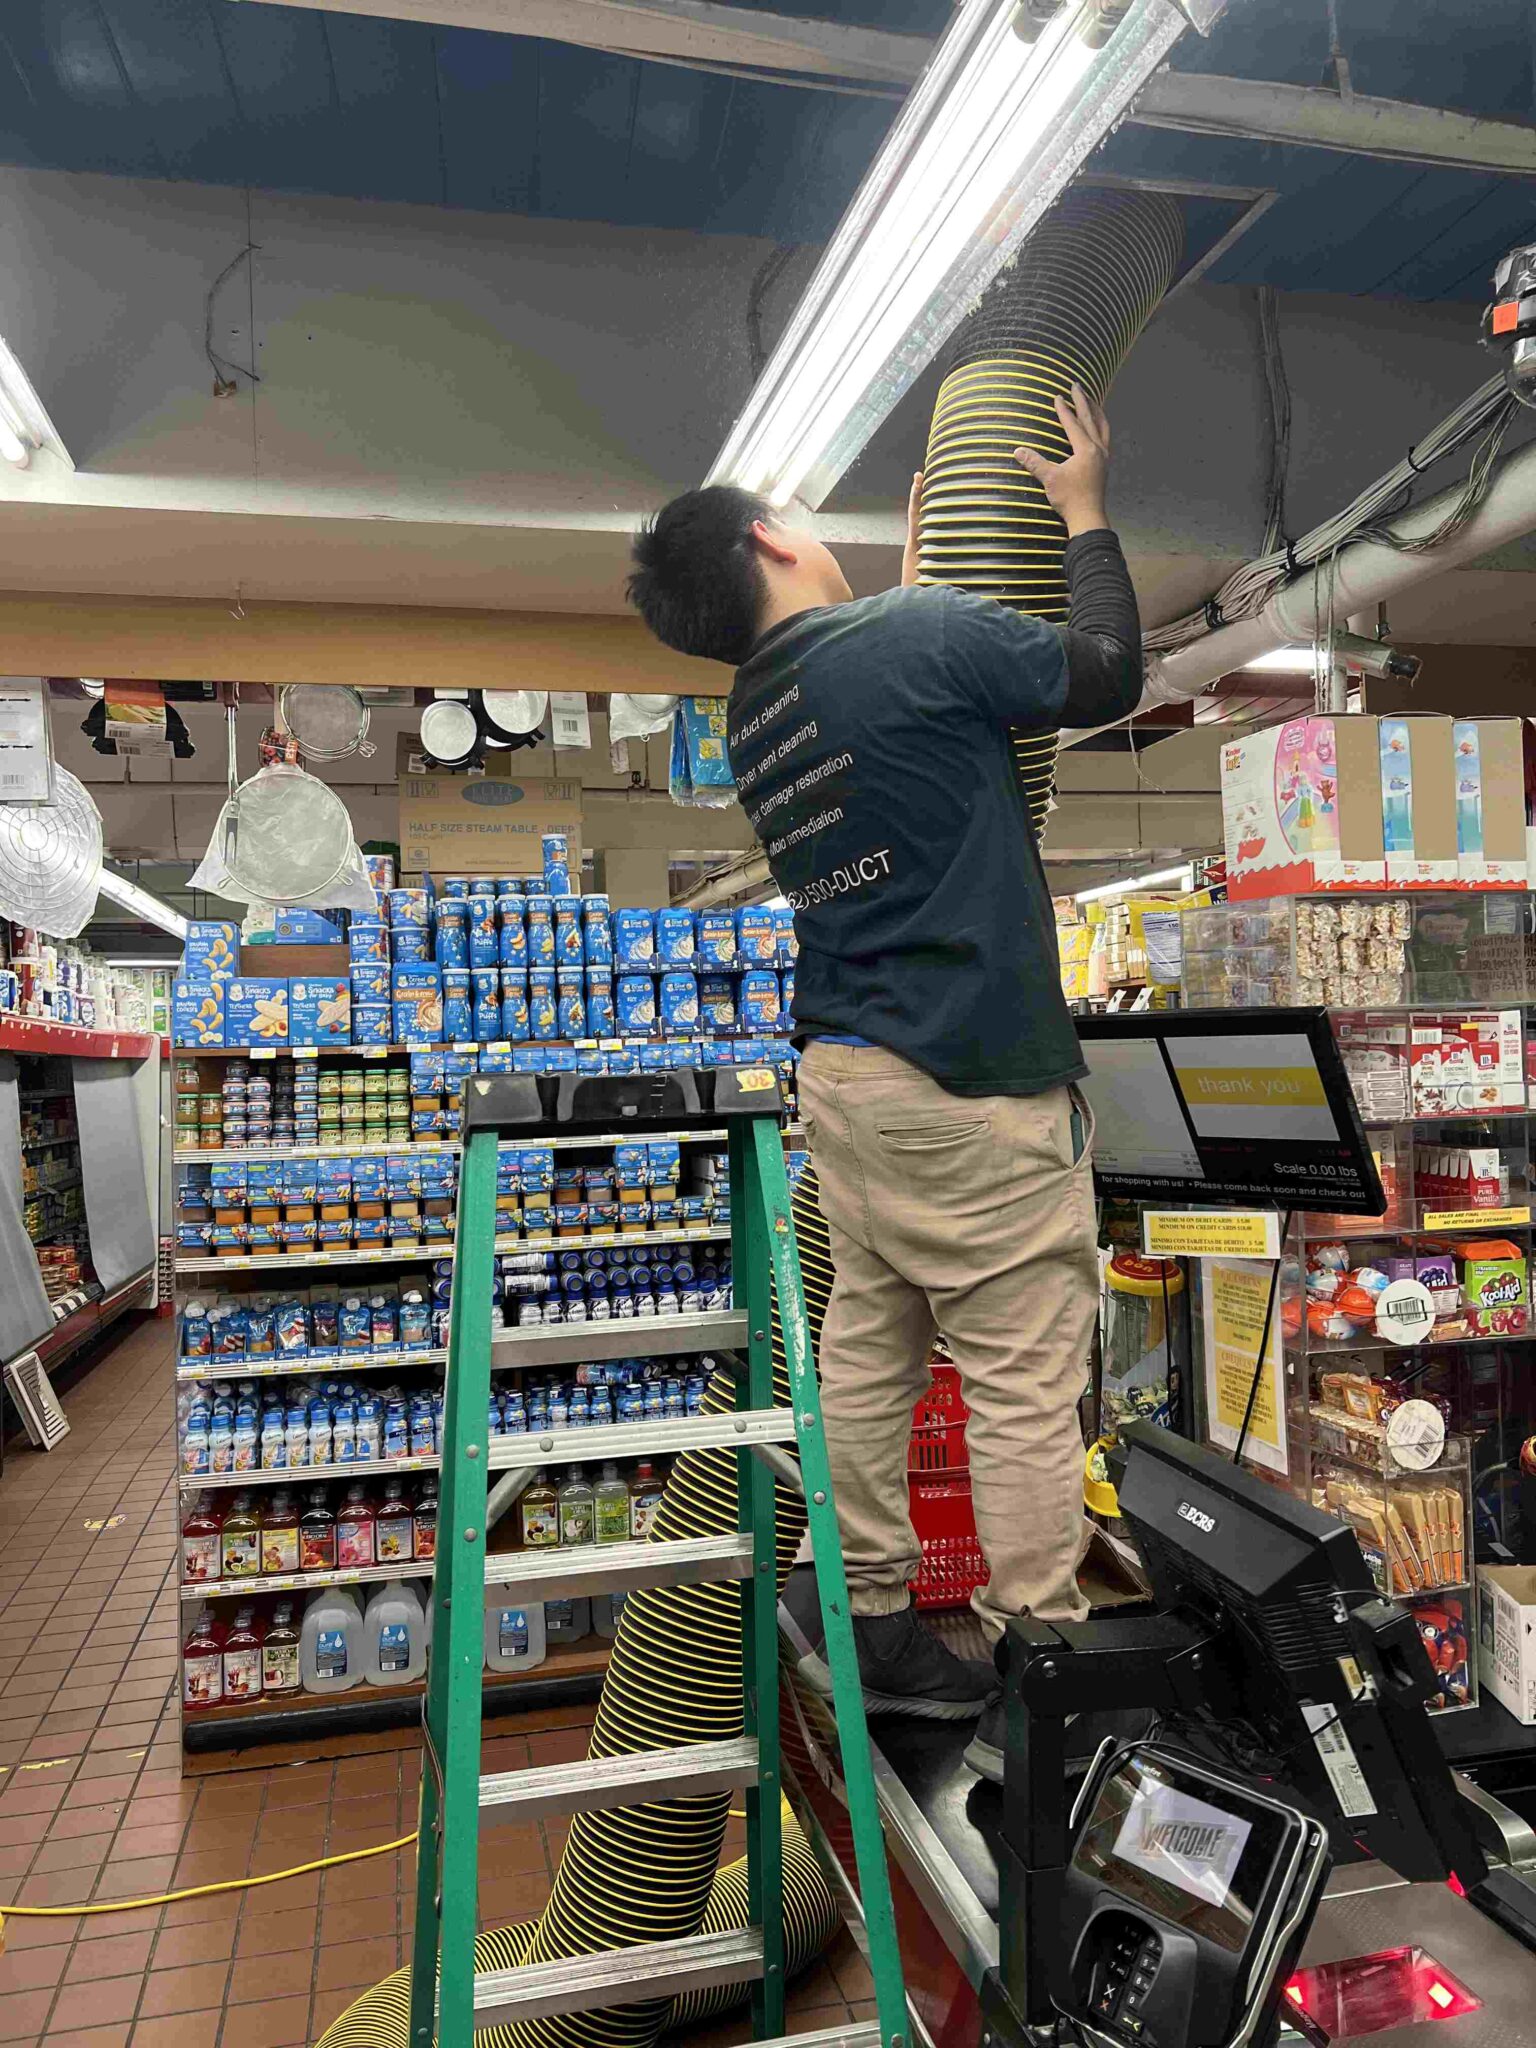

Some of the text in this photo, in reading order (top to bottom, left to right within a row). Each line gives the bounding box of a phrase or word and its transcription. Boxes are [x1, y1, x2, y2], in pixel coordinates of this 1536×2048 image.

[730, 684, 800, 749] Air duct cleaning
[757, 749, 777, 773] vent
[778, 720, 818, 758] cleaning
[760, 785, 794, 816] damage
[796, 753, 854, 793] restoration
[409, 823, 435, 832] HALF
[440, 823, 464, 832] SIZE
[465, 824, 502, 833] STEAM
[504, 824, 538, 833] TABLE
[547, 825, 575, 834] DEEP
[1198, 1077, 1300, 1096] thank you
[1274, 1162, 1358, 1177] Scale 0.00 lbs
[1101, 1175, 1113, 1183] for
[1114, 1176, 1151, 1186] shopping
[1194, 1181, 1222, 1190] Please
[1250, 1185, 1271, 1193] back
[1273, 1187, 1297, 1195] soon
[1299, 1187, 1317, 1196] and
[1318, 1188, 1347, 1197] check
[1350, 1190, 1366, 1198] out
[1473, 1195, 1500, 1203] Vanilla
[1480, 1278, 1520, 1307] Kool-Aid
[1186, 1506, 1216, 1533] ECRS
[1142, 1824, 1225, 1857] WELCOME
